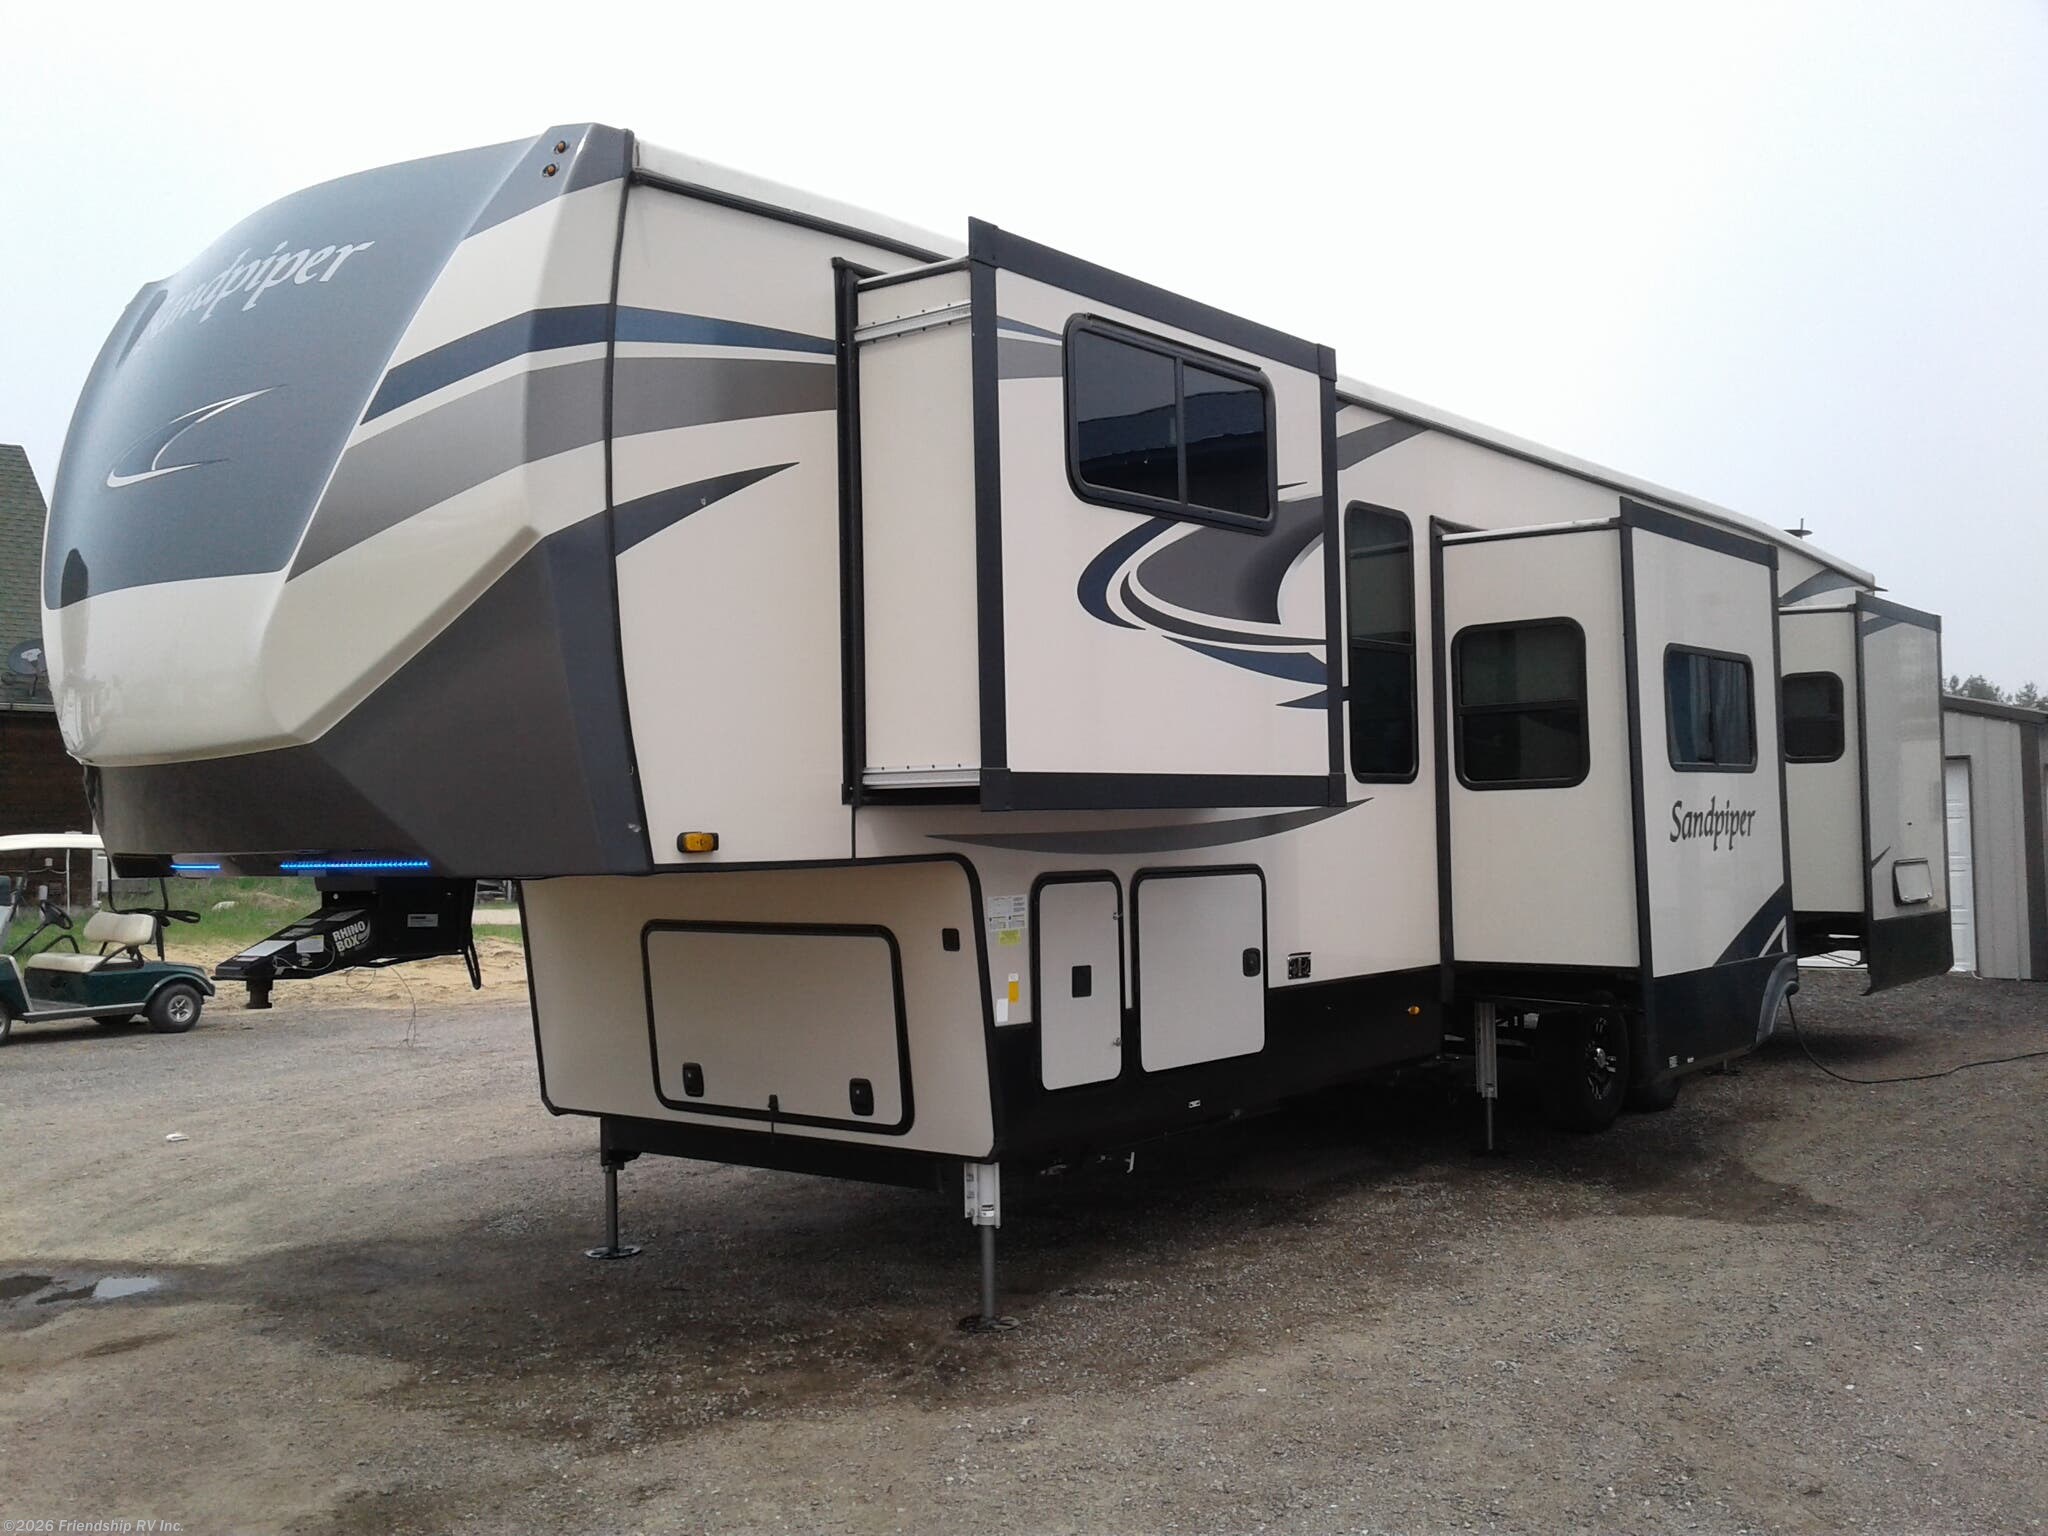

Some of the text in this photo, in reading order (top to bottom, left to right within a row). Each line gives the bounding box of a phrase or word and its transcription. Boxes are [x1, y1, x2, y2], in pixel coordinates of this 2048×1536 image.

[1669, 795, 1756, 852] Sandpiper
[332, 920, 366, 942] RHINO
[335, 934, 361, 952] BOX
